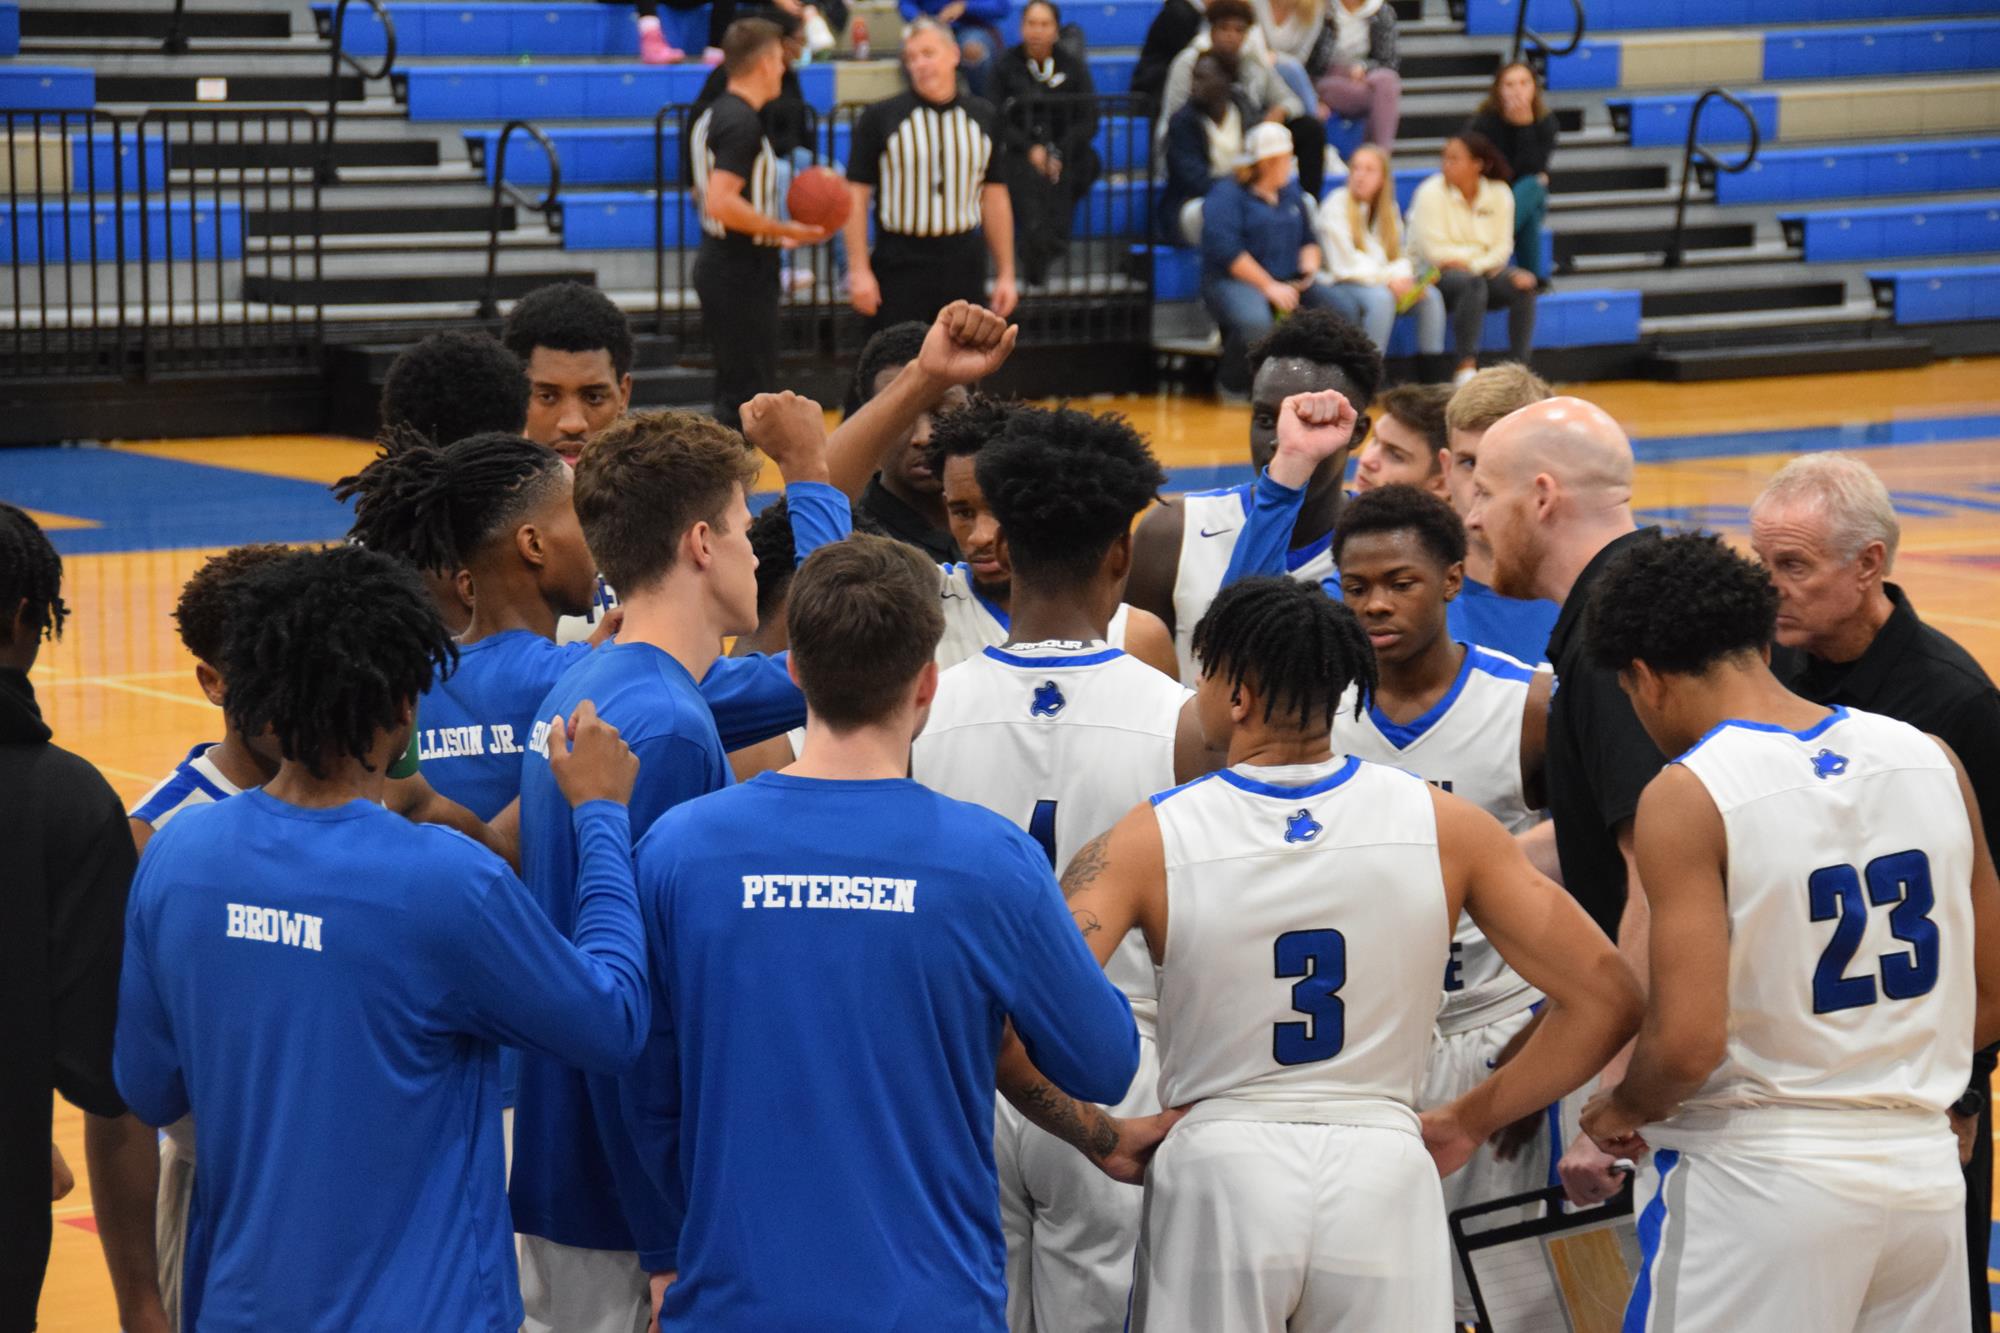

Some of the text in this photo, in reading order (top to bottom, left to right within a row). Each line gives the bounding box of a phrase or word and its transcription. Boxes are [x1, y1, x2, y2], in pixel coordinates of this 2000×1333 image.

[417, 724, 524, 760] LLISON JR.
[742, 875, 917, 913] PETERSEN
[226, 903, 323, 952] BROWN
[1808, 849, 1940, 1015] 23
[1273, 928, 1347, 1066] 3
